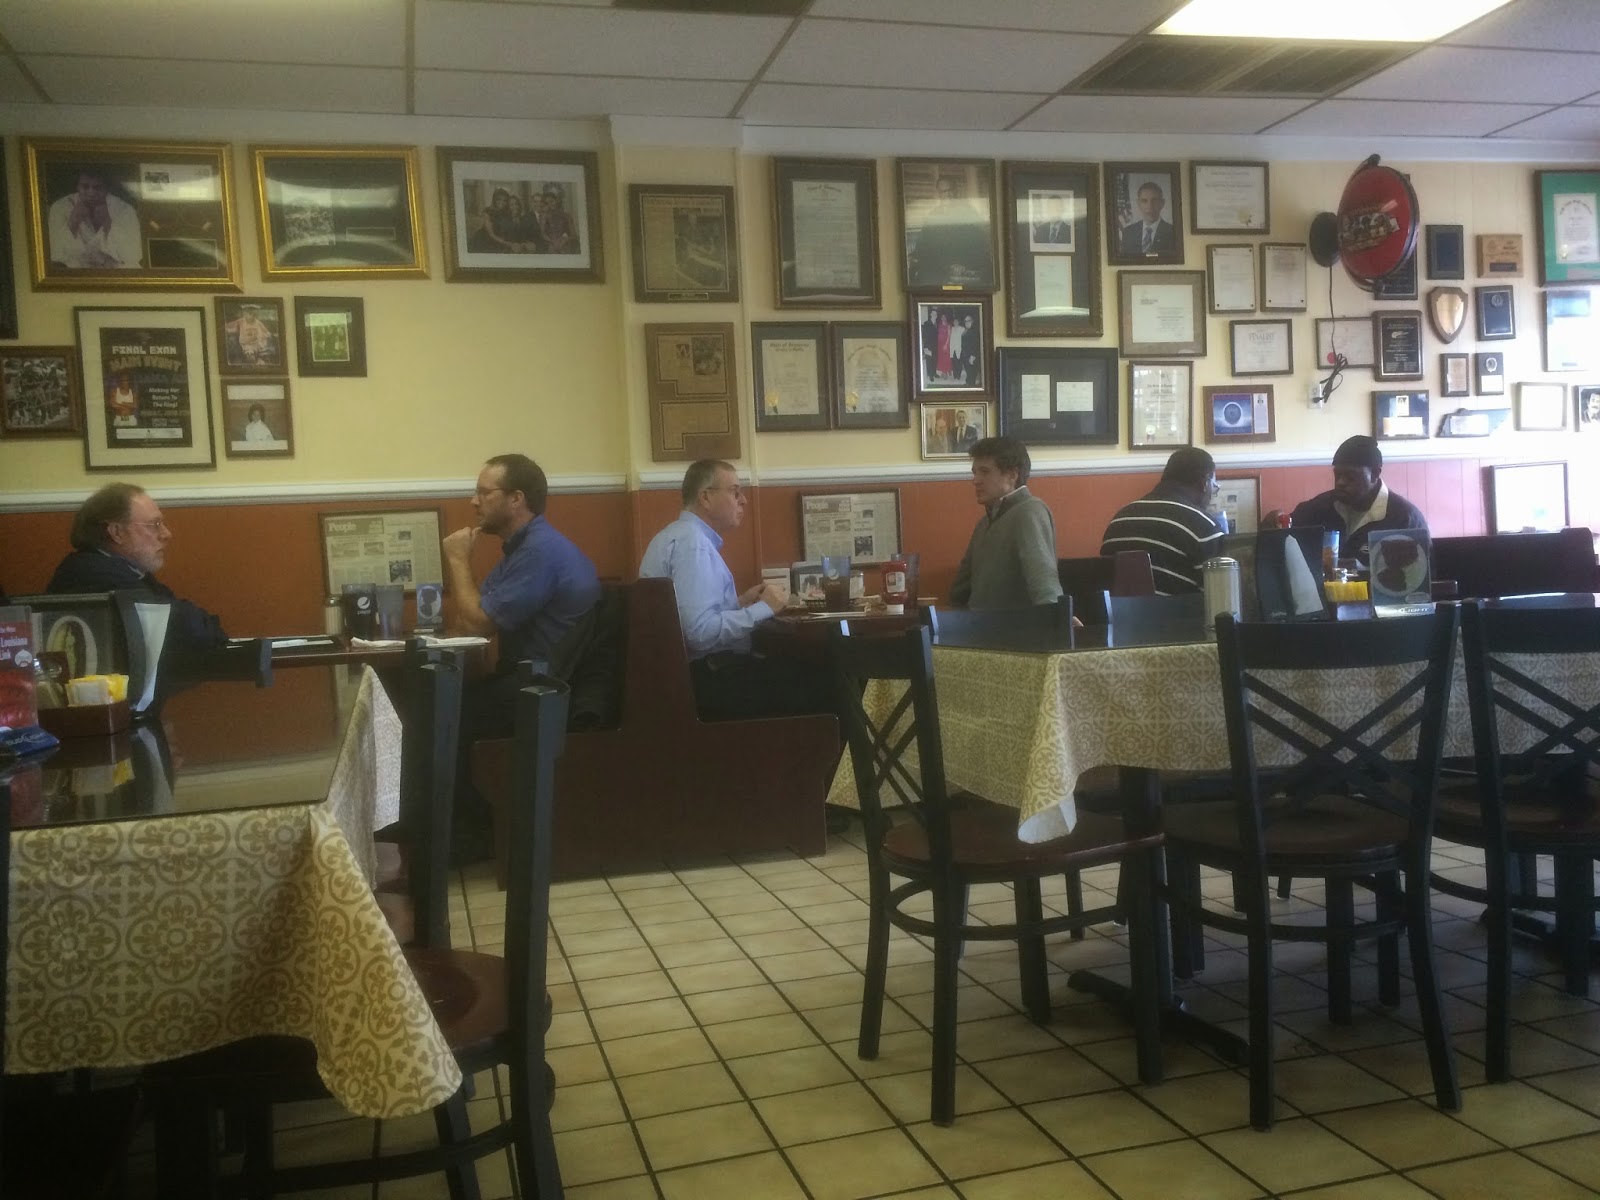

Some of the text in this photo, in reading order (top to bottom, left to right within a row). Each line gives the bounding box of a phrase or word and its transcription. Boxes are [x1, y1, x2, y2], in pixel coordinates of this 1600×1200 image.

[112, 345, 146, 354] FINAL
[806, 500, 829, 511] People
[328, 521, 356, 534] People
[0, 636, 28, 648] Louisiana
